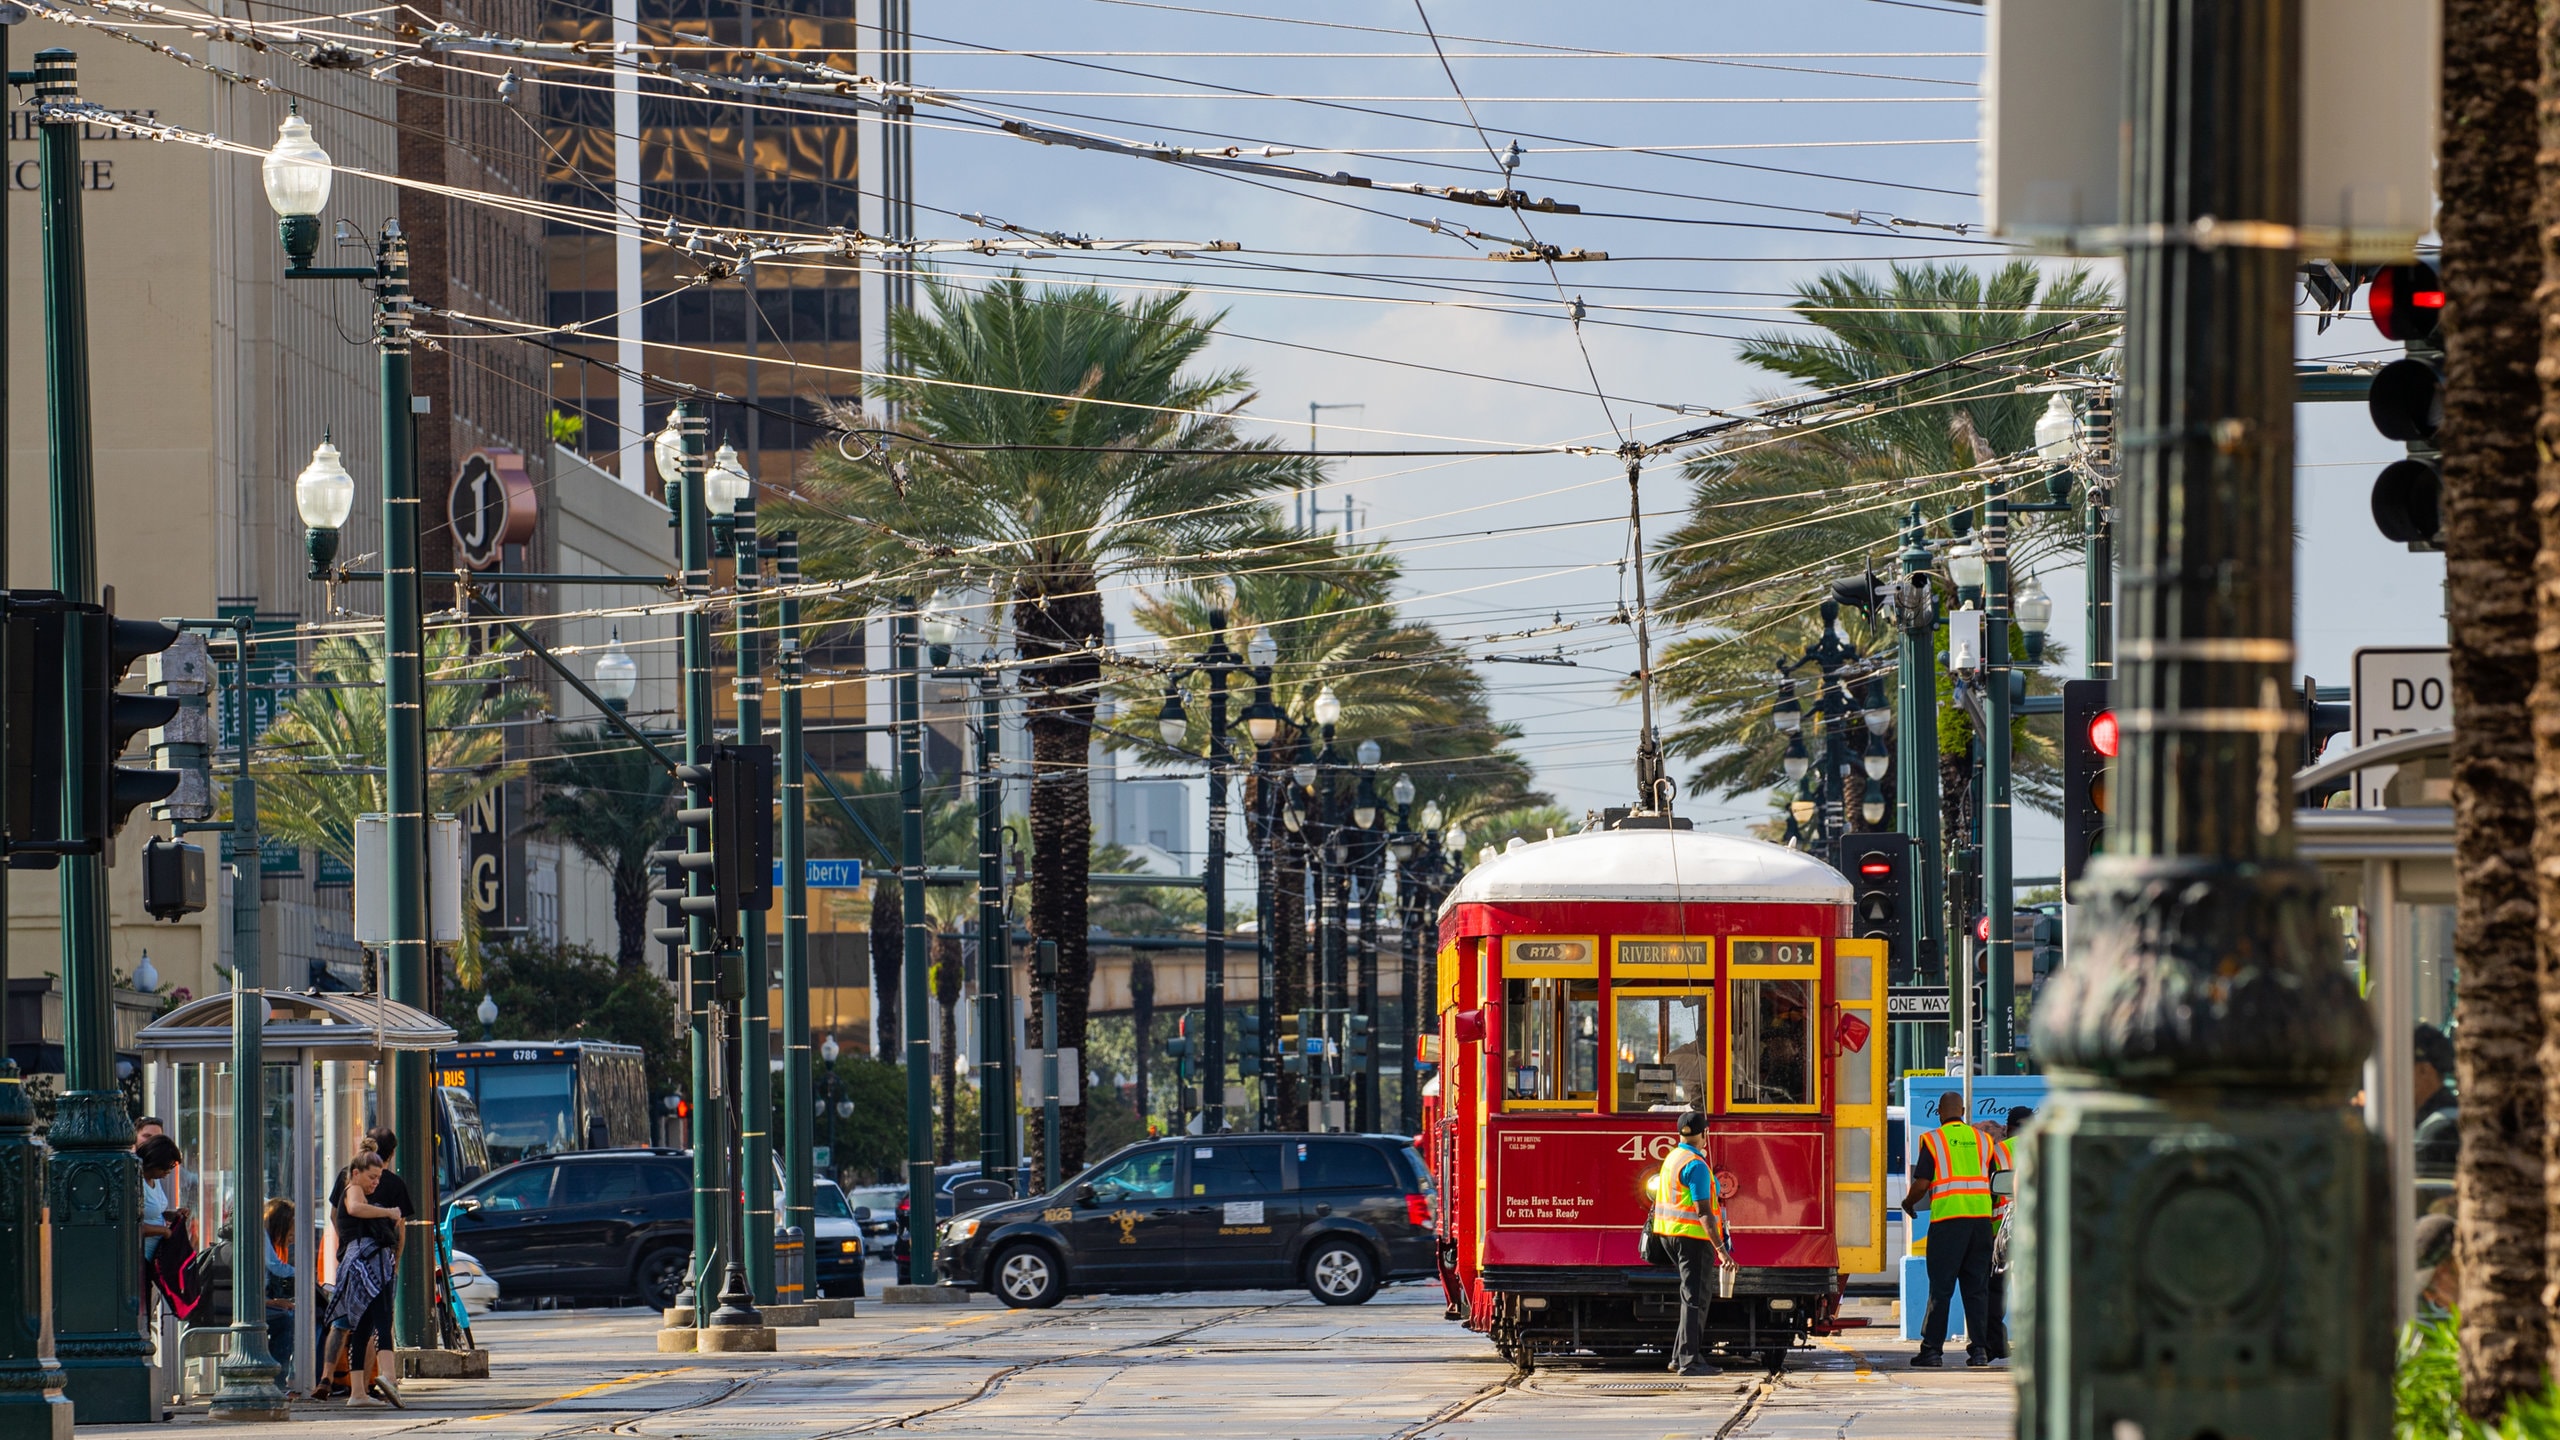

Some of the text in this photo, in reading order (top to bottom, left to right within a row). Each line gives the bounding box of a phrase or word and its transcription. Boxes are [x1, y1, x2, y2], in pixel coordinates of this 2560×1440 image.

[465, 470, 488, 548] J
[806, 862, 849, 886] iberty
[1529, 946, 1556, 958] RTA
[1621, 946, 1703, 963] RIVERFRONT
[1889, 998, 1950, 1011] ONE WAY
[513, 1050, 538, 1061] 6786
[443, 1070, 466, 1087] BUS
[1506, 1196, 1594, 1206] Please Have Exact Fare
[1042, 1207, 1073, 1222] 1025
[1506, 1208, 1580, 1220] Or RTA Pass Ready
